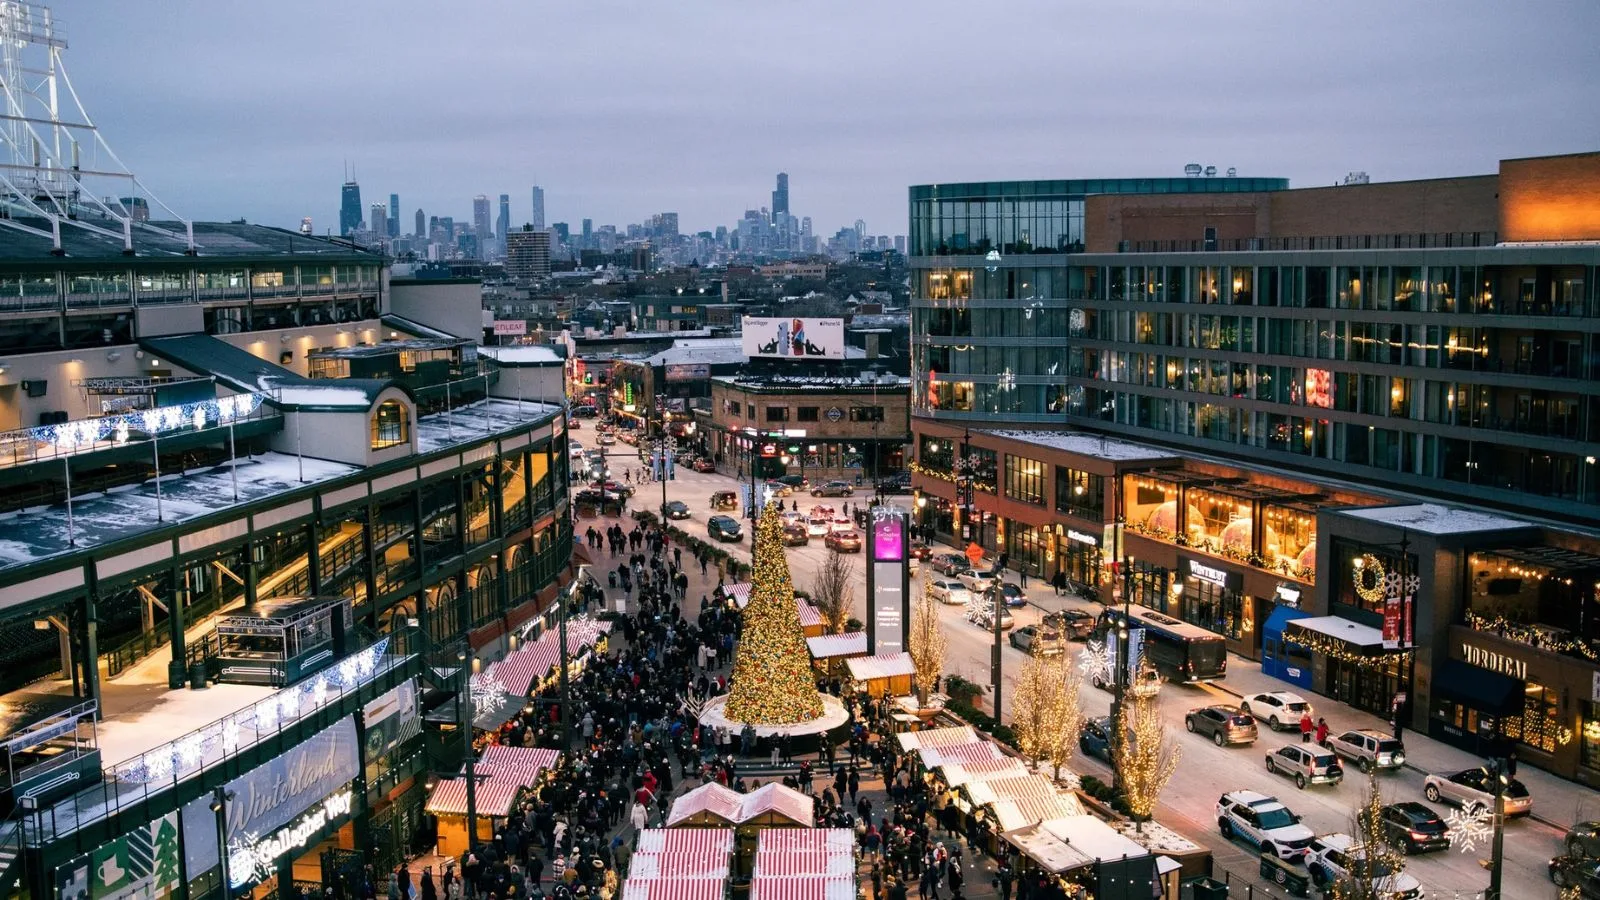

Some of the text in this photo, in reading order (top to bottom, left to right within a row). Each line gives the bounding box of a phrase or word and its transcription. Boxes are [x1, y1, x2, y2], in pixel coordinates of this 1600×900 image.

[1300, 627, 1347, 650] ZACHARY
[1463, 643, 1527, 680] MORDECAI
[225, 731, 337, 842] Winterland
[259, 809, 326, 863] Gallagher
[324, 791, 353, 820] Way
